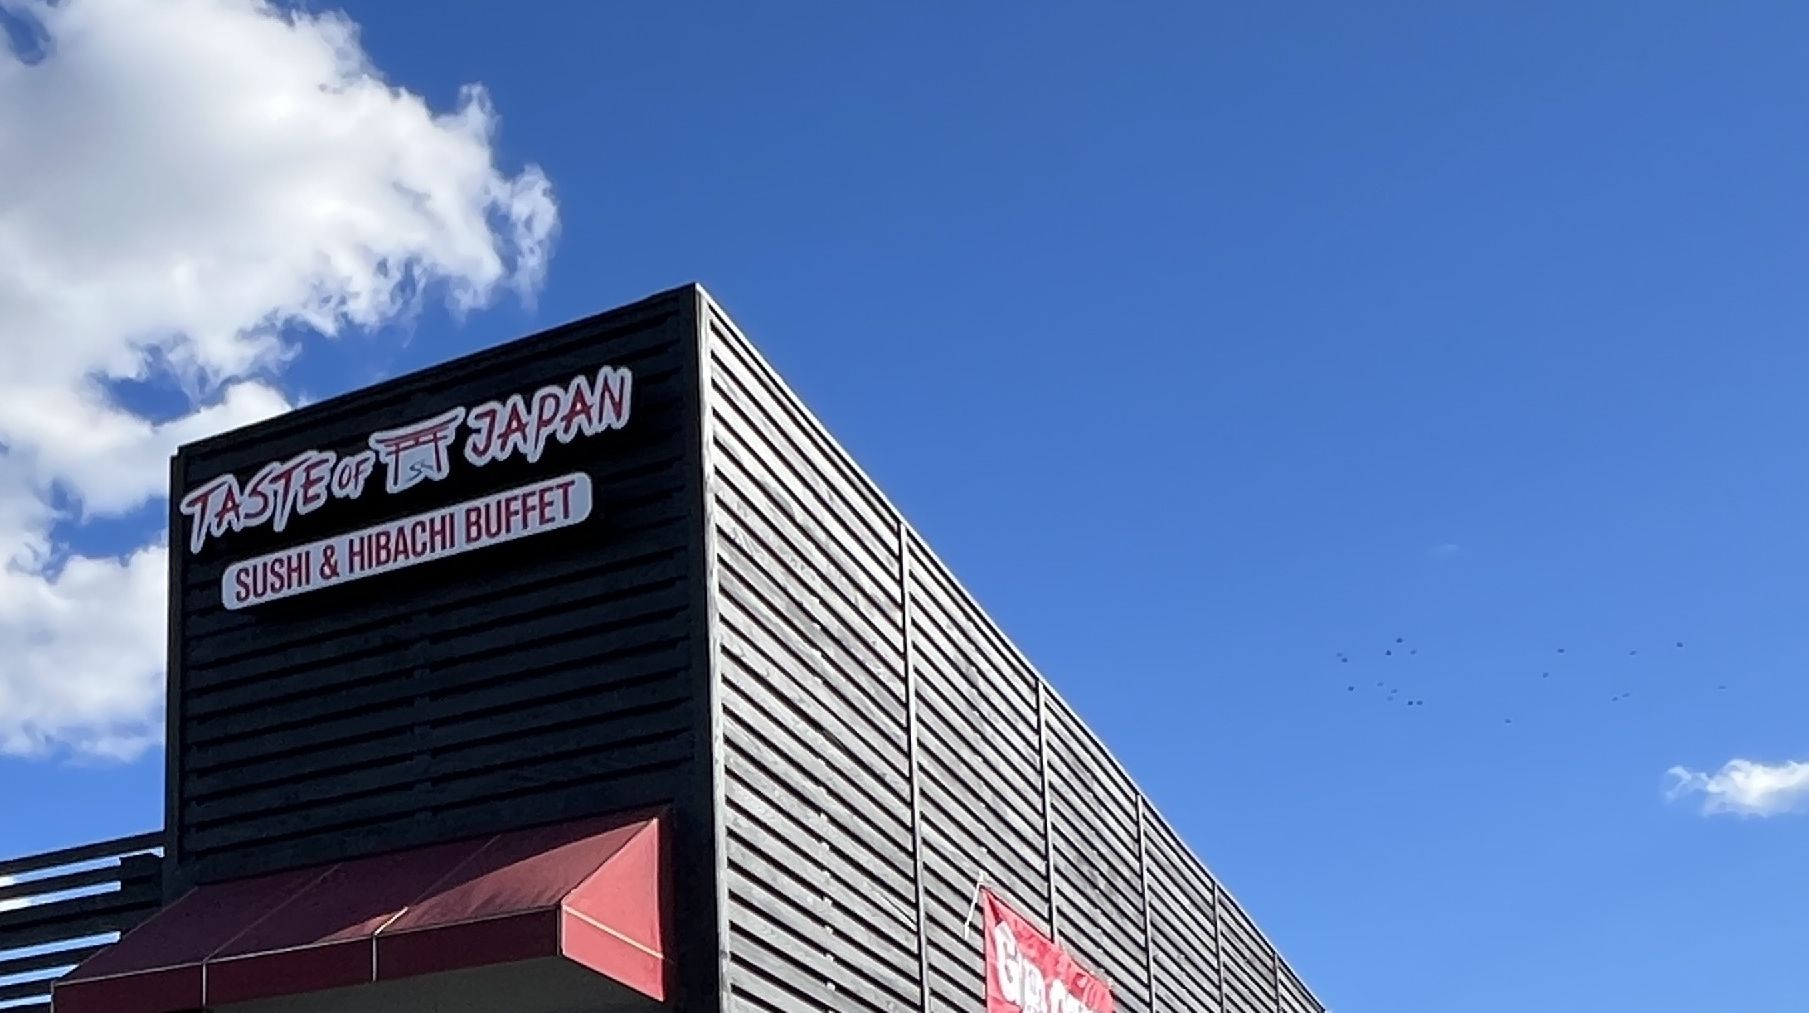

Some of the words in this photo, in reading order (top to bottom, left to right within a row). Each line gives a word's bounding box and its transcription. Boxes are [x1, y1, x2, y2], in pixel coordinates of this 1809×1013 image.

[183, 453, 333, 549] TASTE
[336, 454, 372, 495] OF
[469, 369, 629, 459] JAPAN
[235, 556, 311, 603] SUSHI
[319, 544, 340, 580] &
[348, 512, 456, 574] HIBACHI
[464, 479, 577, 544] BUFFET
